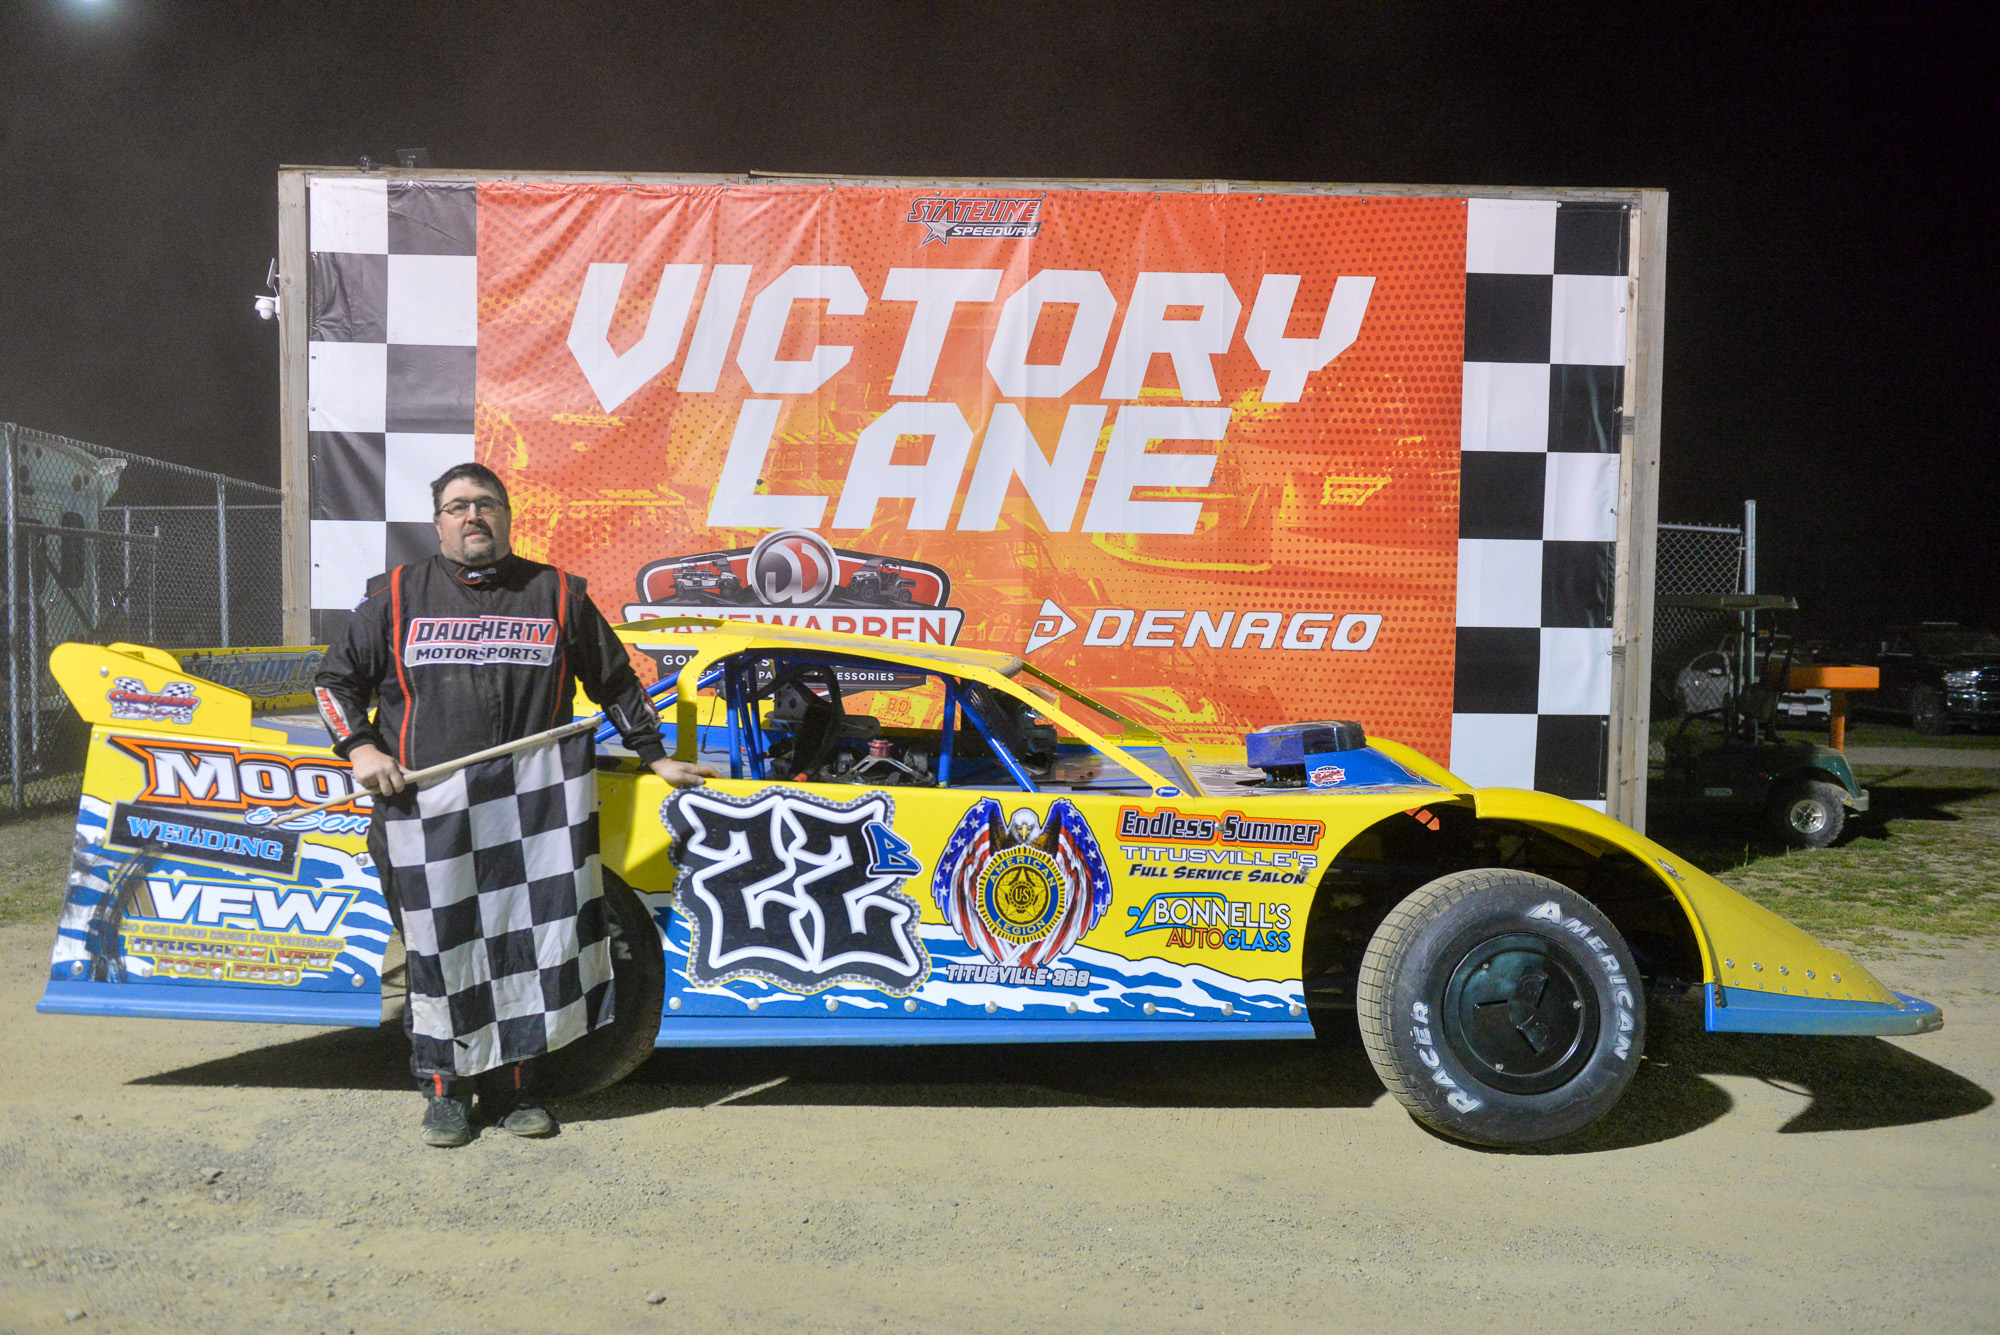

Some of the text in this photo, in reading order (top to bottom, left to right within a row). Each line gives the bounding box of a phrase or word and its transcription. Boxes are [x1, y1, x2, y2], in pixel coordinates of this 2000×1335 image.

[907, 198, 1042, 223] STATELINE
[951, 226, 1037, 237] SPEEDWAY
[567, 263, 1377, 414] VICTORY
[706, 400, 1232, 534] LANE
[414, 620, 552, 643] DAUGHERTY
[1083, 608, 1383, 651] DENAGO
[416, 646, 542, 661] MOTORSPORTS
[317, 688, 352, 737] INTEGRA
[127, 816, 284, 861] WELDING
[1120, 809, 1320, 845] Endless Summer
[990, 855, 1057, 887] AMERICAN
[1120, 845, 1318, 868] TITUSVILLE'S
[678, 793, 920, 977] 22
[1129, 863, 1308, 885] FULL SERVICE SALON
[147, 880, 346, 933] VFW
[1154, 897, 1291, 929] BONNELL'S
[172, 926, 207, 939] DOES
[209, 929, 247, 942] MORE
[250, 932, 276, 945] FOR
[279, 935, 345, 950] VETERANS
[995, 918, 1046, 936] LEGION
[130, 938, 332, 967] TITUSVILLE VFW
[157, 957, 226, 976] POST
[946, 963, 1048, 986] TITUSVILLE
[1527, 901, 1635, 1061] AMERICAN
[1411, 1000, 1482, 1115] RACER
